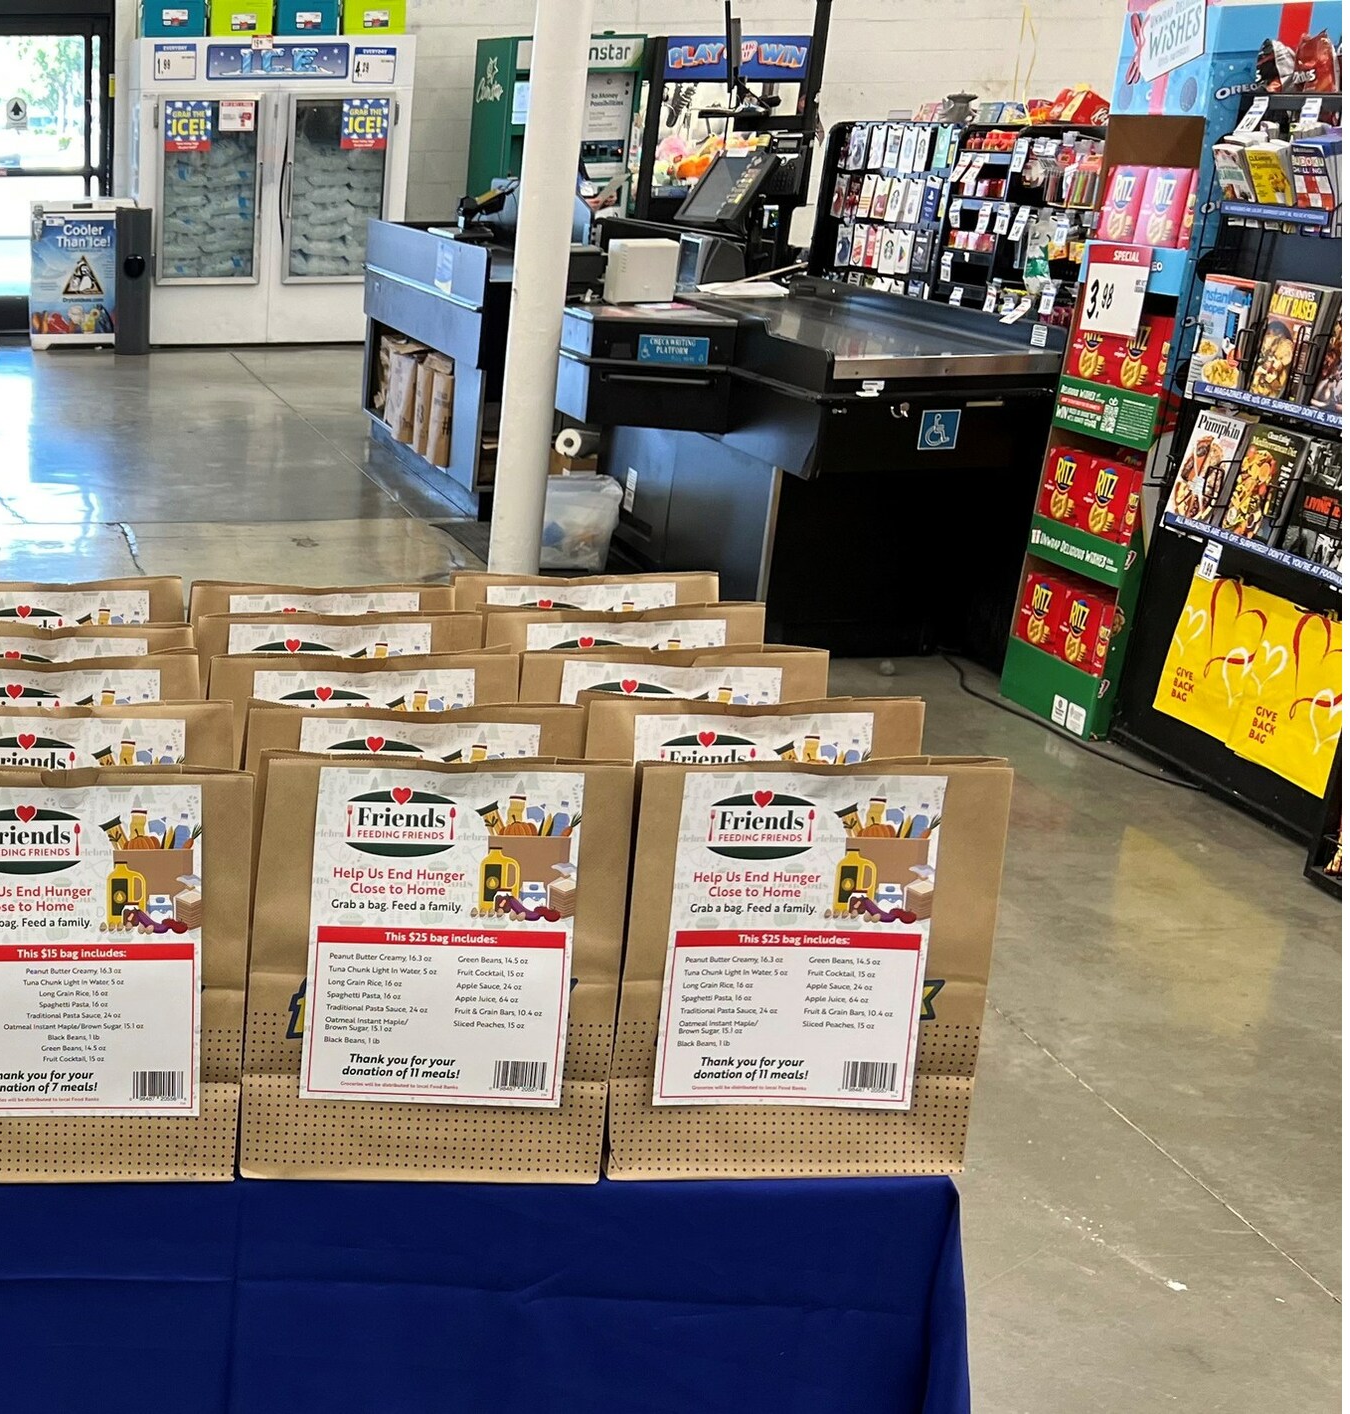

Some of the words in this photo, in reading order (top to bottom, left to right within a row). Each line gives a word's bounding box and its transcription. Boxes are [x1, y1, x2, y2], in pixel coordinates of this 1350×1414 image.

[240, 47, 319, 73] ICE
[589, 44, 631, 60] nstar
[668, 43, 725, 69] PLAY
[757, 43, 807, 69] WIN
[349, 108, 367, 116] GRAB
[171, 118, 206, 136] ICE!
[348, 115, 381, 133] ICE!
[1114, 174, 1136, 202] RITZ
[1154, 177, 1177, 205] RITZ
[63, 224, 104, 236] Cooler
[57, 236, 85, 247] Than
[1113, 250, 1139, 263] SPECIAL
[1086, 279, 1115, 319] 3.98
[1270, 293, 1291, 316] PLANT
[1291, 301, 1317, 321] BASED
[1204, 386, 1215, 394] ALL
[1215, 388, 1242, 398] MAGAZINES
[1198, 414, 1241, 440] Pumpkin
[1055, 457, 1077, 486] RITZ
[1094, 469, 1119, 500] RITZ
[1184, 519, 1210, 533] MAGAZINES
[1292, 557, 1312, 571] YOU'RE
[1032, 583, 1053, 612] RITZ
[1070, 600, 1090, 630] RITZ
[1176, 666, 1194, 681] GIVE
[1173, 677, 1195, 693] BACK
[1171, 688, 1187, 702] BAG
[1256, 706, 1278, 722] GIVE
[1252, 717, 1277, 735] BACK
[1248, 729, 1266, 744] BAG
[357, 807, 445, 828] Friends
[719, 810, 804, 830] Friends
[718, 834, 758, 842] FEEDING
[760, 834, 802, 842] FRIENDS
[738, 934, 759, 943] This
[762, 934, 780, 944] $25
[782, 935, 801, 946] bag
[803, 935, 850, 945] includes:
[701, 1057, 734, 1067] Thank
[736, 1059, 757, 1069] you
[759, 1057, 776, 1069] for
[778, 1060, 804, 1070] your
[693, 1070, 742, 1079] donation
[744, 1070, 757, 1081] of
[759, 1070, 767, 1079] 11
[770, 1070, 808, 1080] meals!
